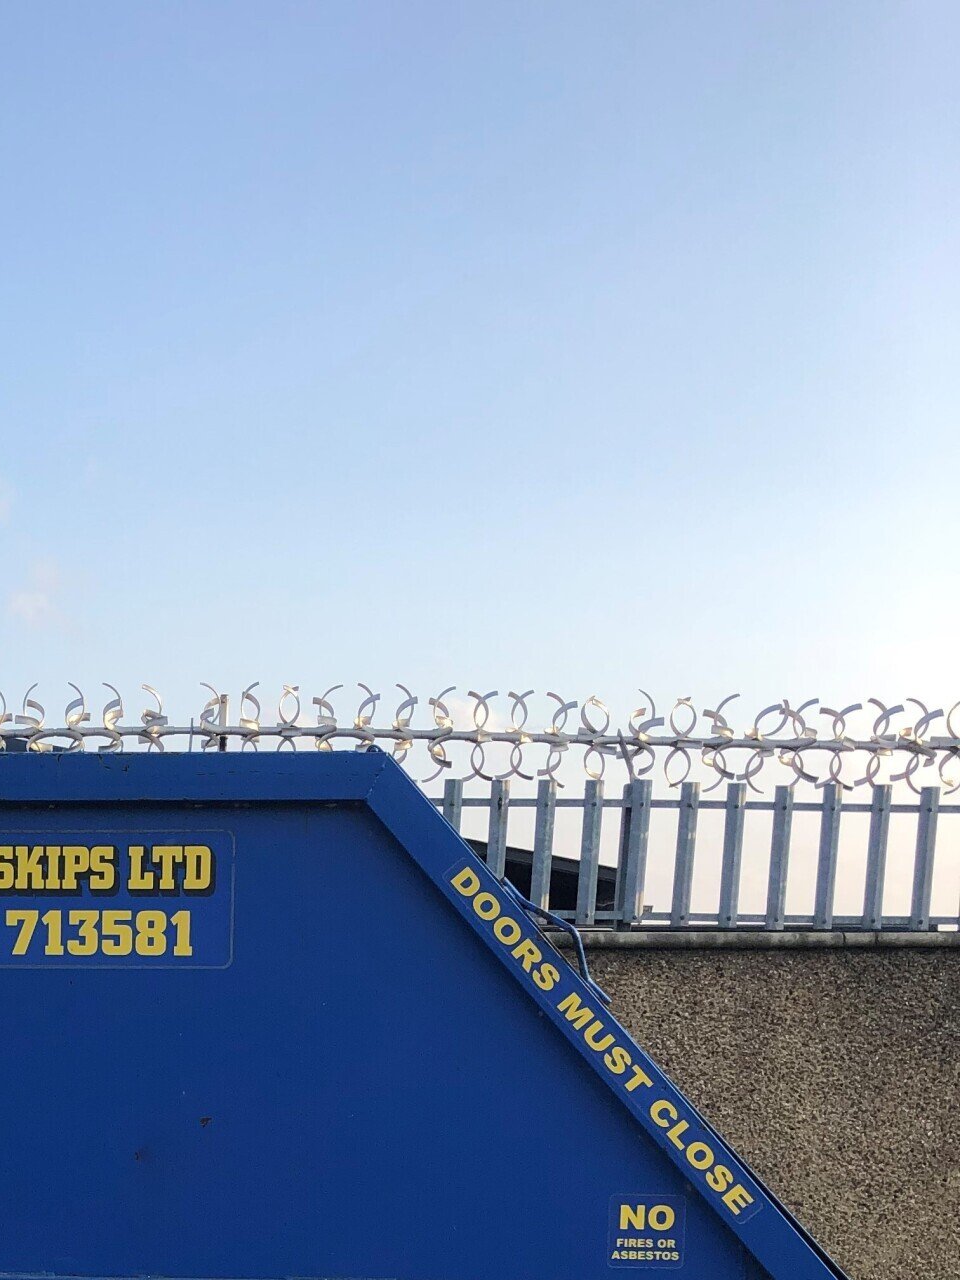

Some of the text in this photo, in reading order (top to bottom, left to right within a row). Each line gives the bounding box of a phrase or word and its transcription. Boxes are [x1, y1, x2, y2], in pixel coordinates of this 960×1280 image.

[127, 845, 214, 892] LTD
[6, 909, 192, 957] 713581
[451, 867, 754, 1215] DOORS MUST CLOSE
[619, 1204, 675, 1231] NO
[611, 1250, 680, 1261] ASBESTOS
[616, 1238, 676, 1249] FIRES OR
